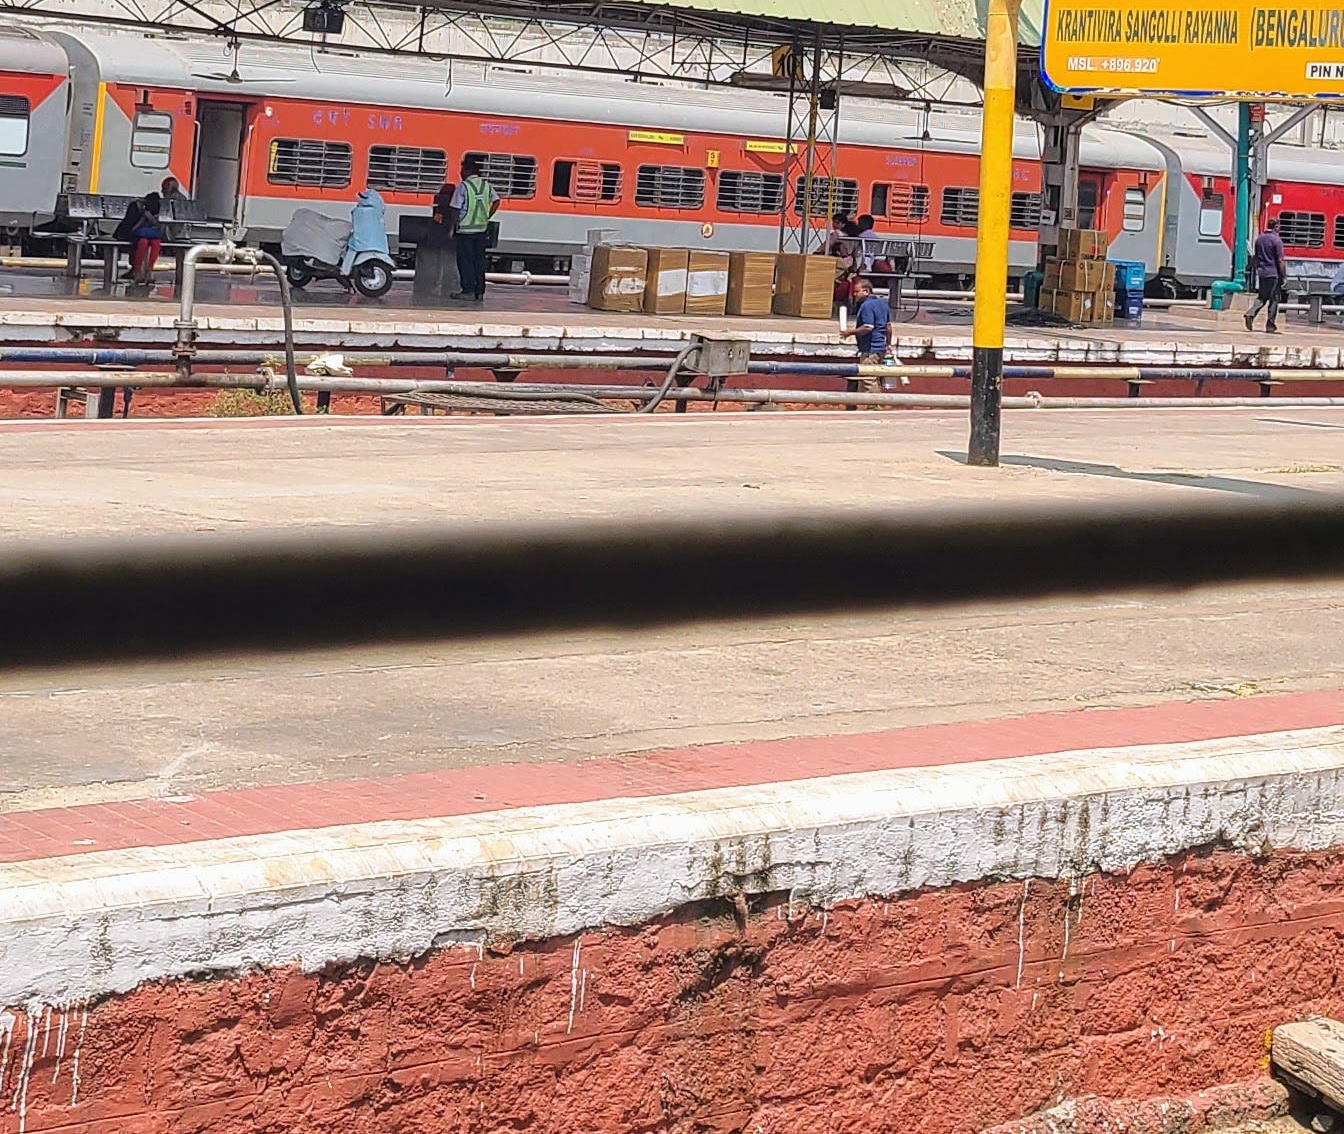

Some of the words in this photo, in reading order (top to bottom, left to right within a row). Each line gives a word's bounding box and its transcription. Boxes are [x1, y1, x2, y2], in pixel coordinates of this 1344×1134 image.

[1056, 9, 1122, 42] KRANTIVIRA
[1125, 9, 1182, 43] SANGOLLI
[1184, 10, 1238, 44] RAYANNA
[1310, 65, 1331, 78] PIN
